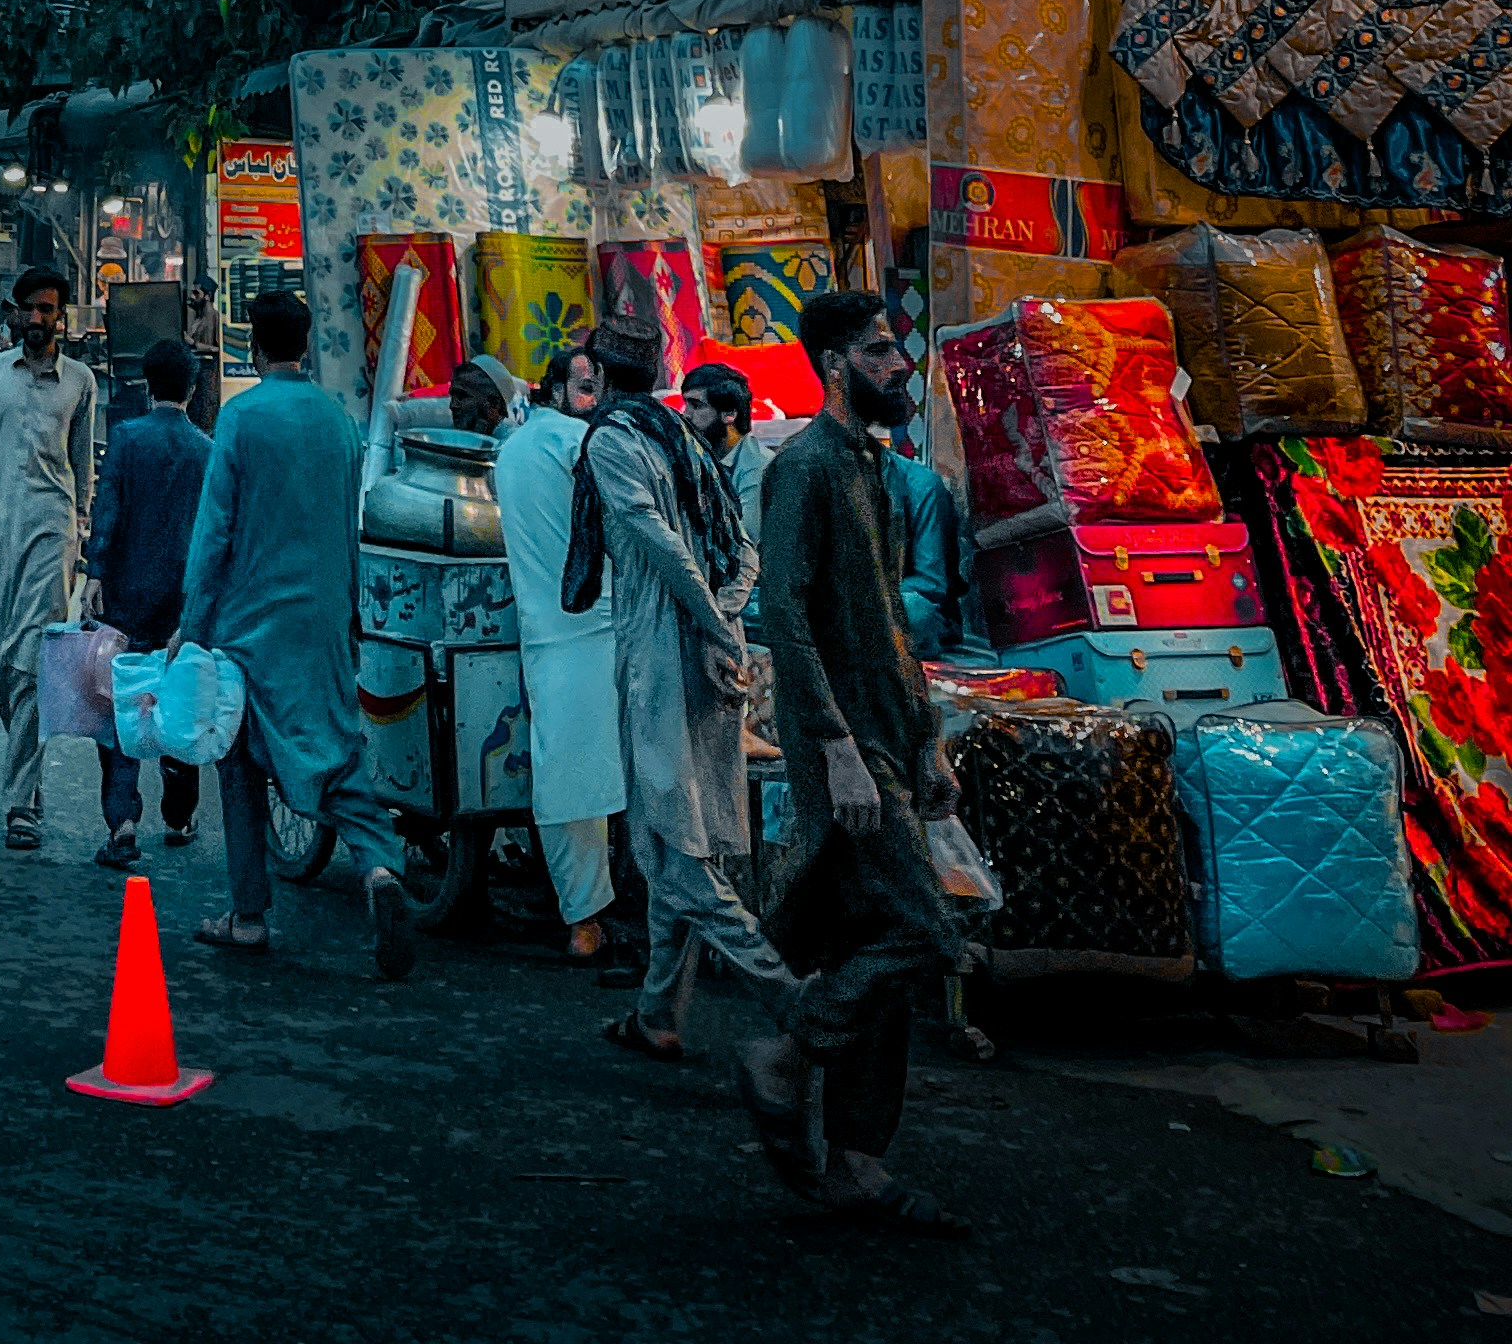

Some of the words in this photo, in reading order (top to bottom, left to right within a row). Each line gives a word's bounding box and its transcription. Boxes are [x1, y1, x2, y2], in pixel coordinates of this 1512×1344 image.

[486, 79, 505, 119] RED
[223, 149, 272, 182] لباس
[931, 210, 1036, 243] MEHRAN
